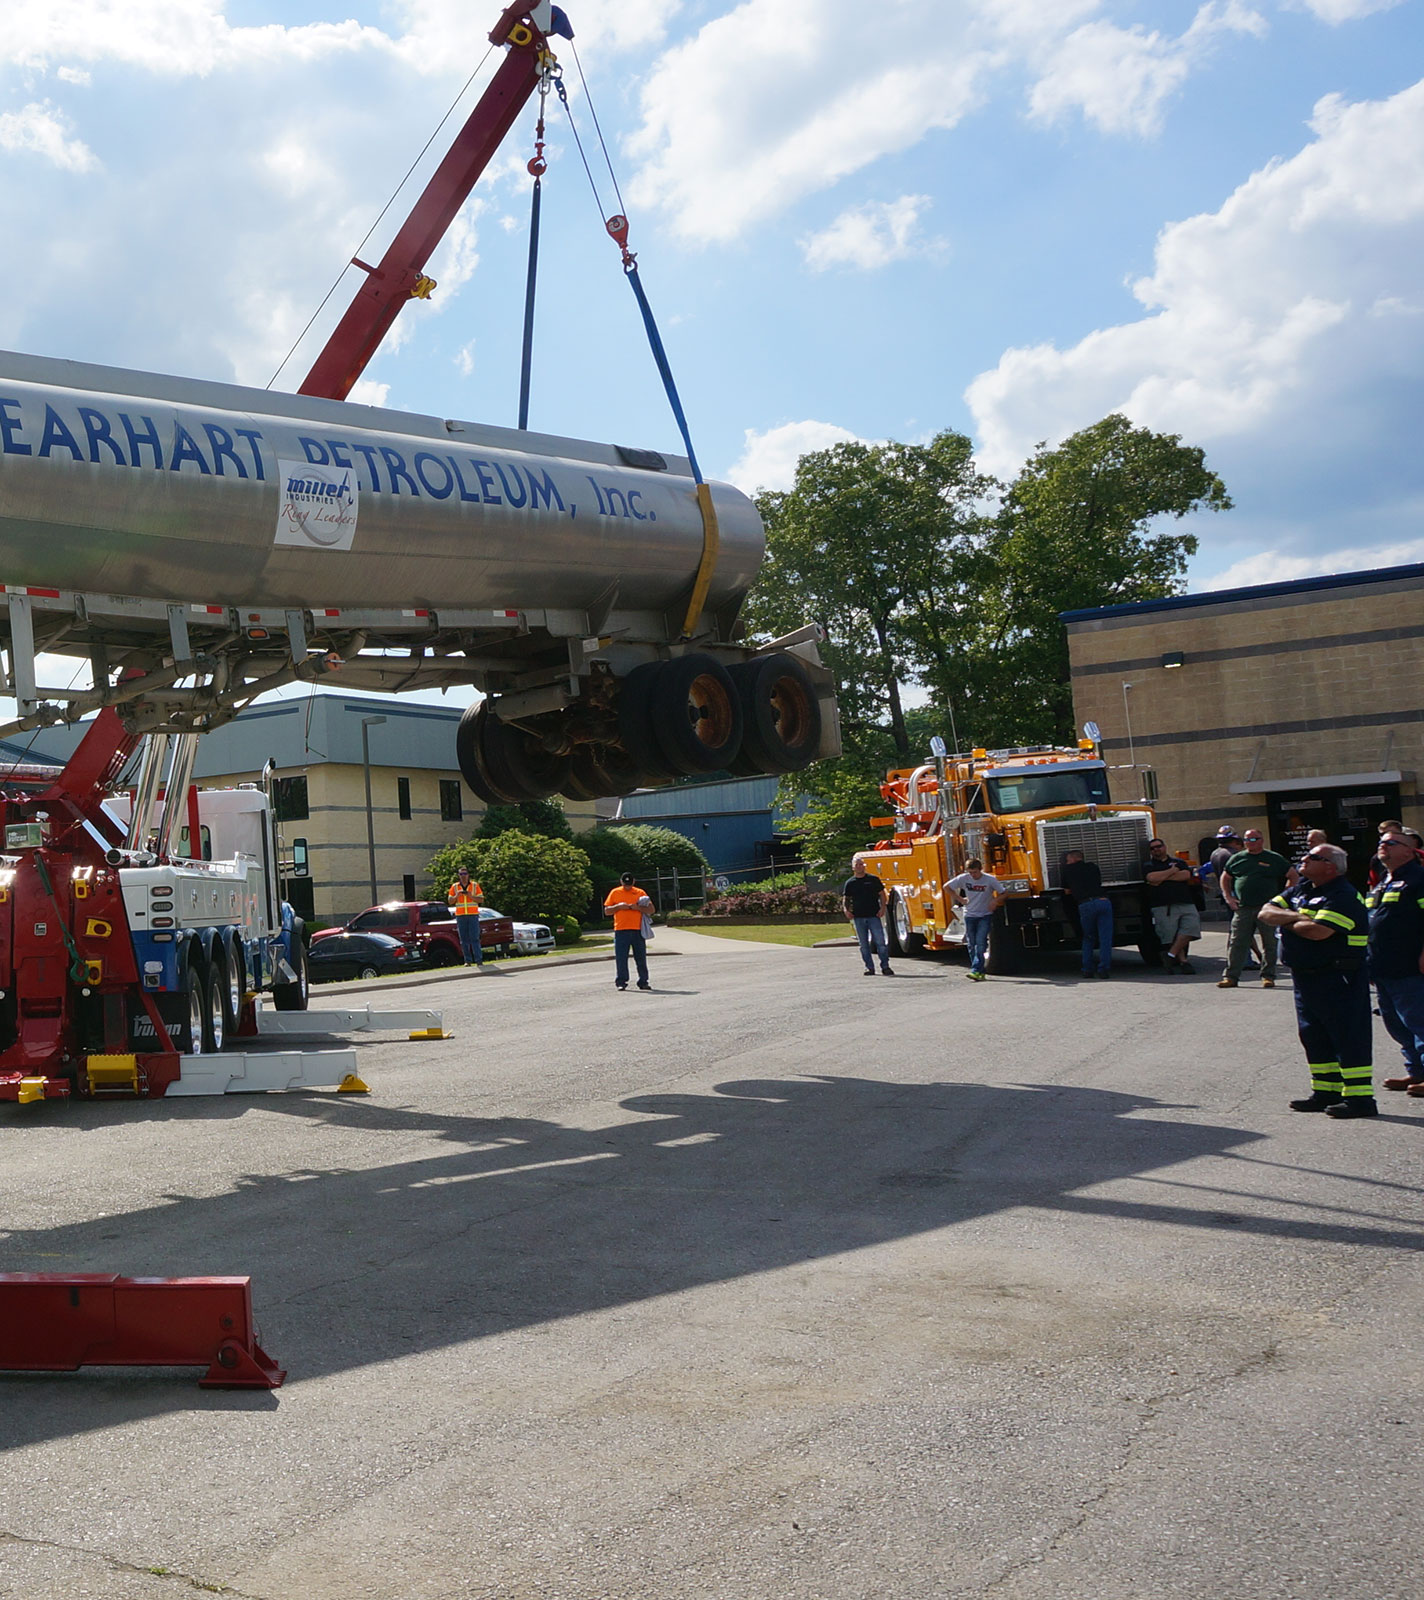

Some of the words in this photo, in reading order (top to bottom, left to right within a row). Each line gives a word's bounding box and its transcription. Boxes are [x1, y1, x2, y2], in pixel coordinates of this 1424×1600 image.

[286, 476, 351, 499] miller
[298, 437, 576, 520] PETROLEUM,
[585, 475, 657, 522] Inc.
[286, 493, 334, 505] INDUSTRIES
[281, 503, 311, 533] Ring
[314, 504, 356, 526] Leaders
[133, 1015, 182, 1037] Vulan
